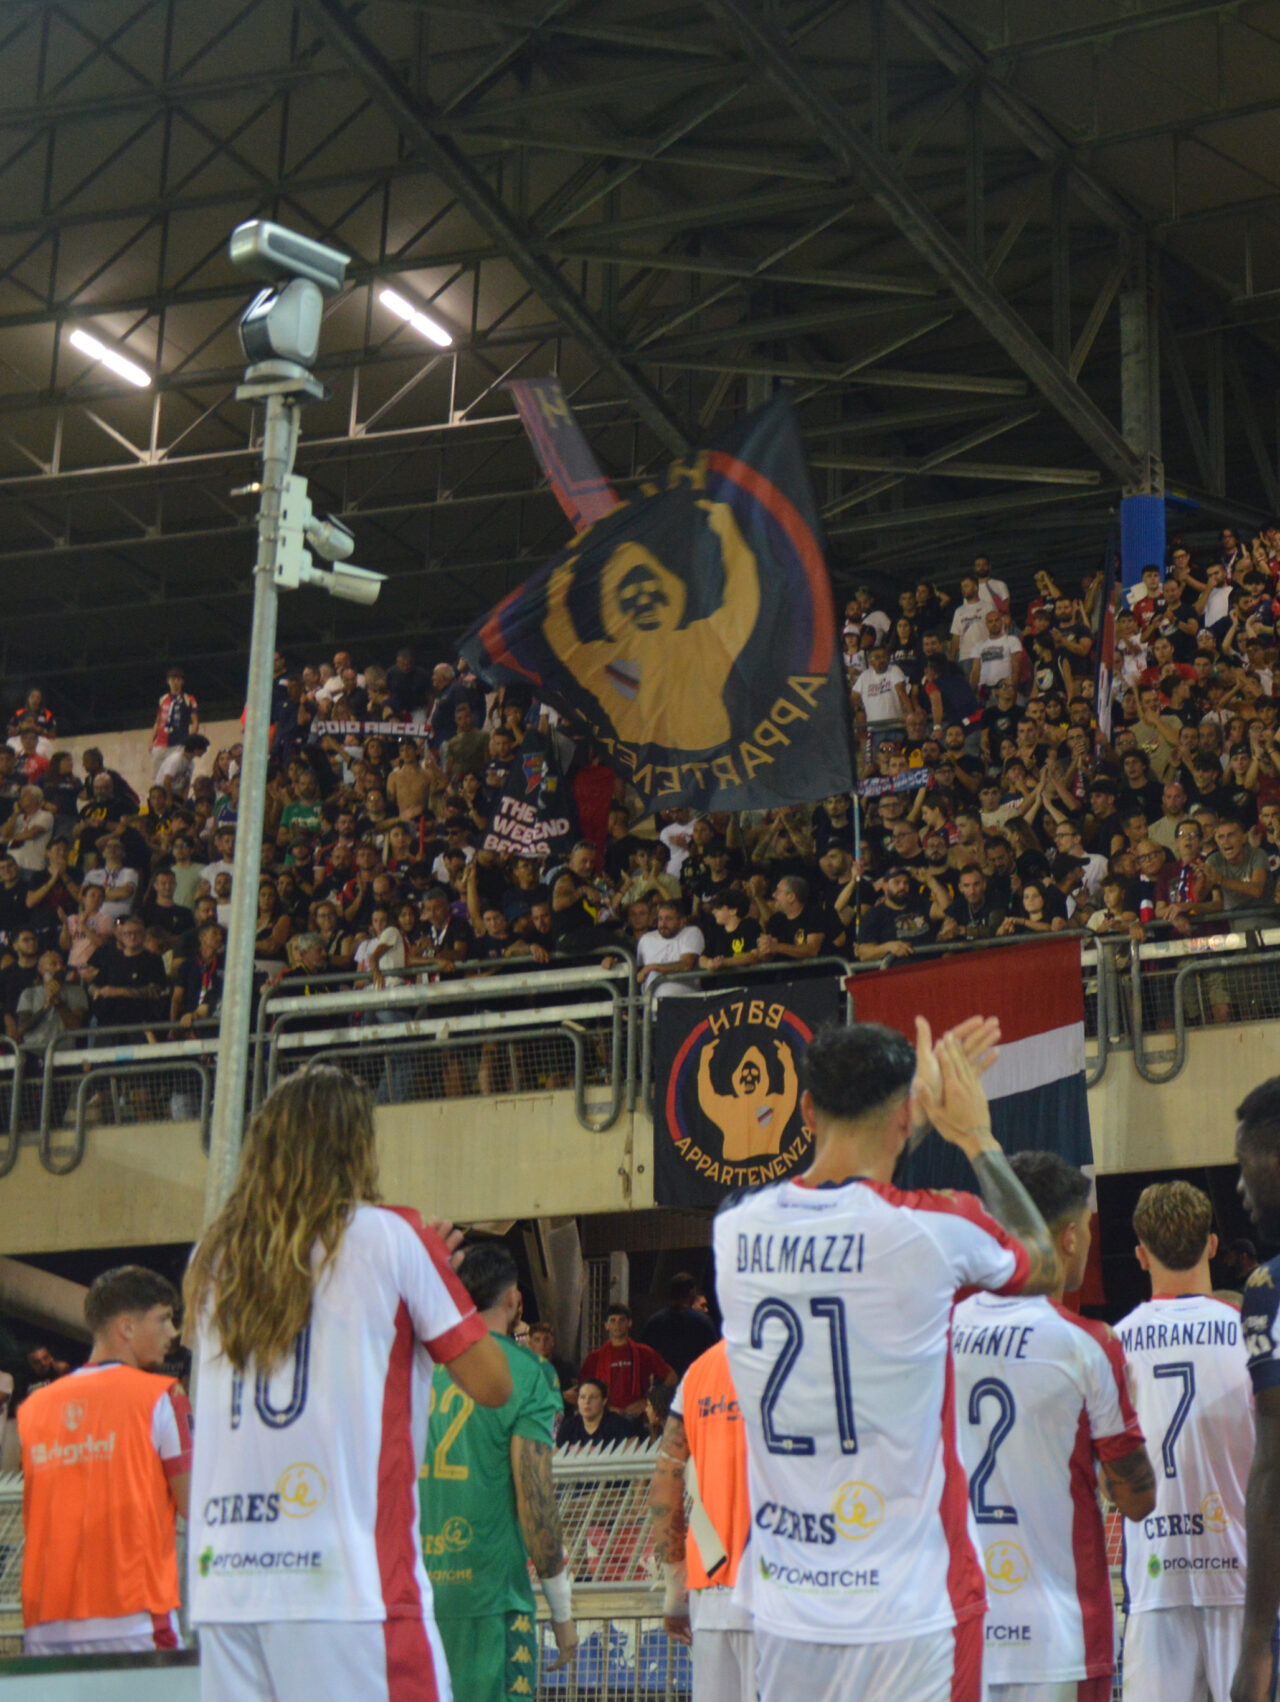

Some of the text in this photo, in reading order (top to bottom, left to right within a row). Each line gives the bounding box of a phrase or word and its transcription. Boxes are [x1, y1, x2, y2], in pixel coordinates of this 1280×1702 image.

[501, 796, 537, 823] THE
[708, 1000, 785, 1035] H769
[675, 1126, 814, 1187] APPARTENENZA
[737, 1233, 865, 1273] DALMAZZI
[953, 1325, 1034, 1359] ATANTE
[1121, 1320, 1237, 1352] MARRANZINO
[750, 1297, 858, 1456] 21
[419, 1383, 474, 1480] 2
[1153, 1361, 1197, 1479] 7
[969, 1377, 1018, 1525] 2
[205, 1493, 280, 1527] CERES
[755, 1501, 837, 1545] CERES
[1144, 1513, 1205, 1540] CERES
